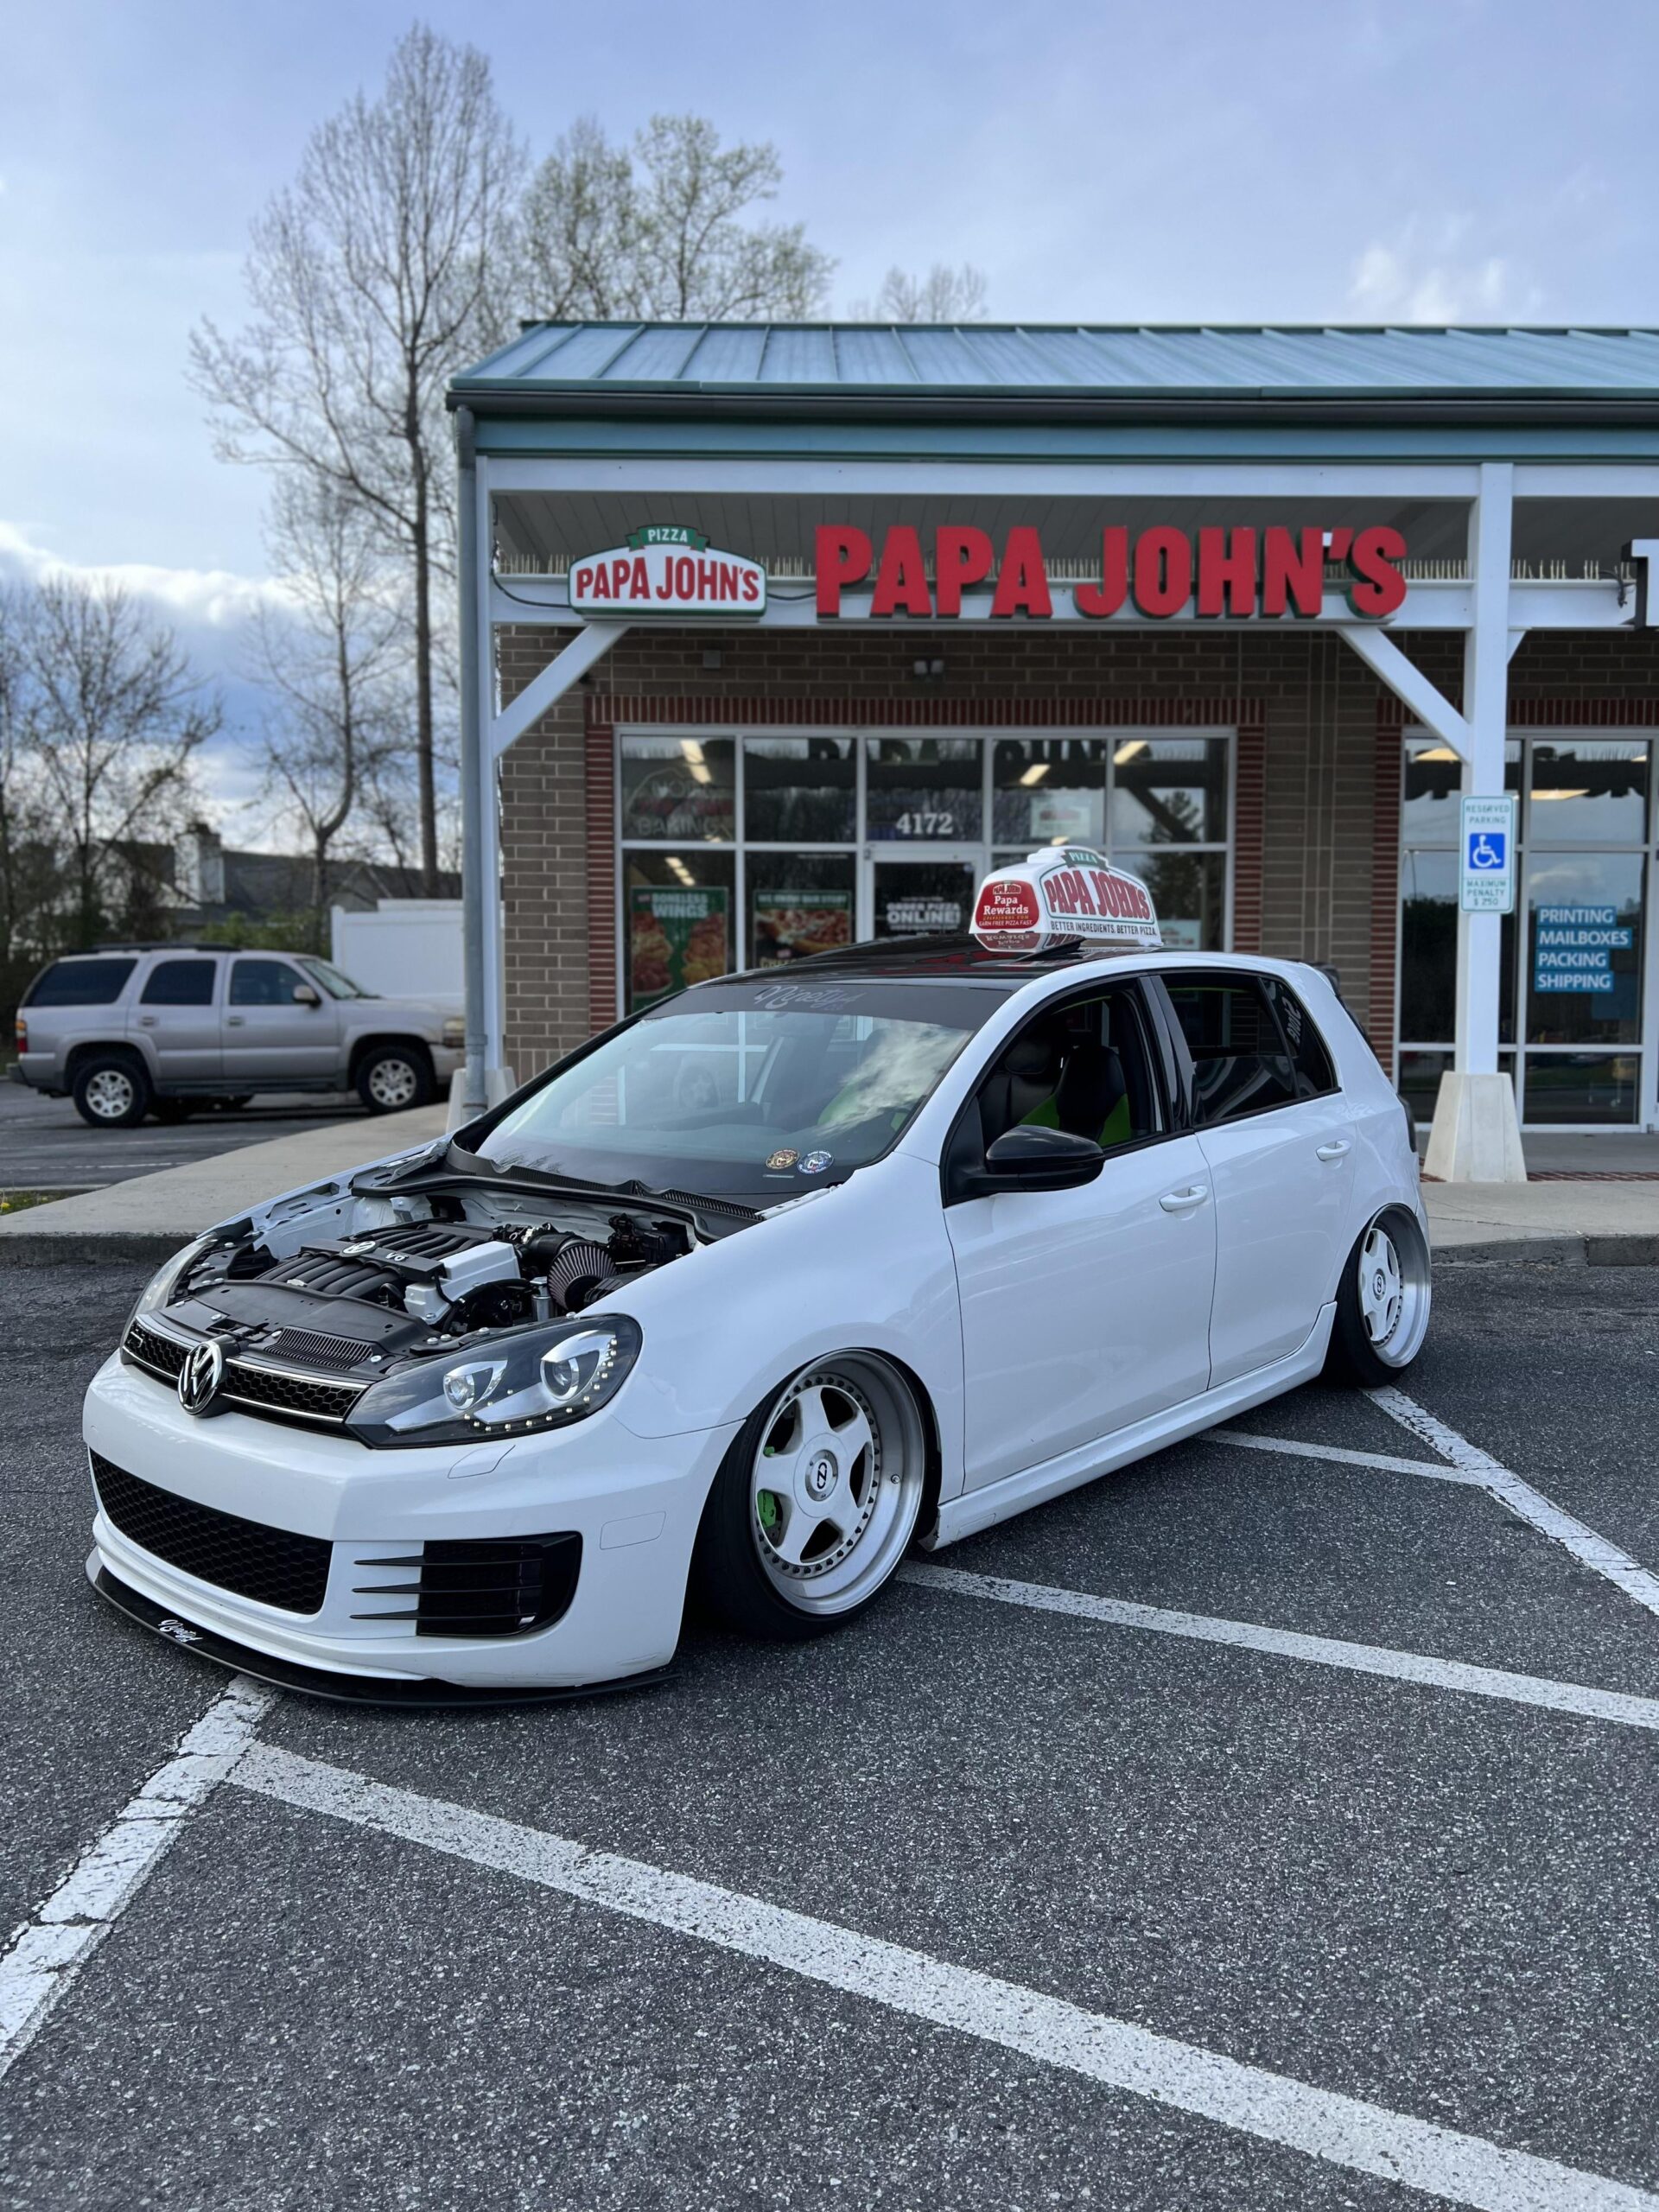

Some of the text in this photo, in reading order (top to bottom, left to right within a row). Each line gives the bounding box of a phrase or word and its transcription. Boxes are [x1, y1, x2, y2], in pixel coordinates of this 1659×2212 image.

[647, 528, 689, 543] PIZZA
[575, 556, 760, 601] PAPA JOHN'S
[816, 526, 1408, 619] PAPA JOHN'S
[1465, 804, 1510, 813] RESERVED
[896, 812, 953, 835] 4172
[1469, 816, 1506, 824] PARKING
[1068, 852, 1097, 863] PIZZA
[1044, 870, 1096, 915] PAPA
[1466, 888, 1505, 897] PENALTY
[995, 895, 1018, 906] Papa
[652, 904, 709, 918] WINGS
[887, 911, 961, 924] ONLINE!
[983, 905, 1028, 915] Rewards
[1540, 908, 1614, 924] PRINTING
[1051, 920, 1074, 931] BETTER
[1076, 922, 1116, 934] INGREDIENTS.
[1116, 925, 1139, 935] BETTER
[1539, 931, 1629, 946] MAILBOXES
[1538, 952, 1607, 968] PACKING
[1538, 974, 1611, 989] SHIPPING
[385, 1252, 409, 1262] V6
